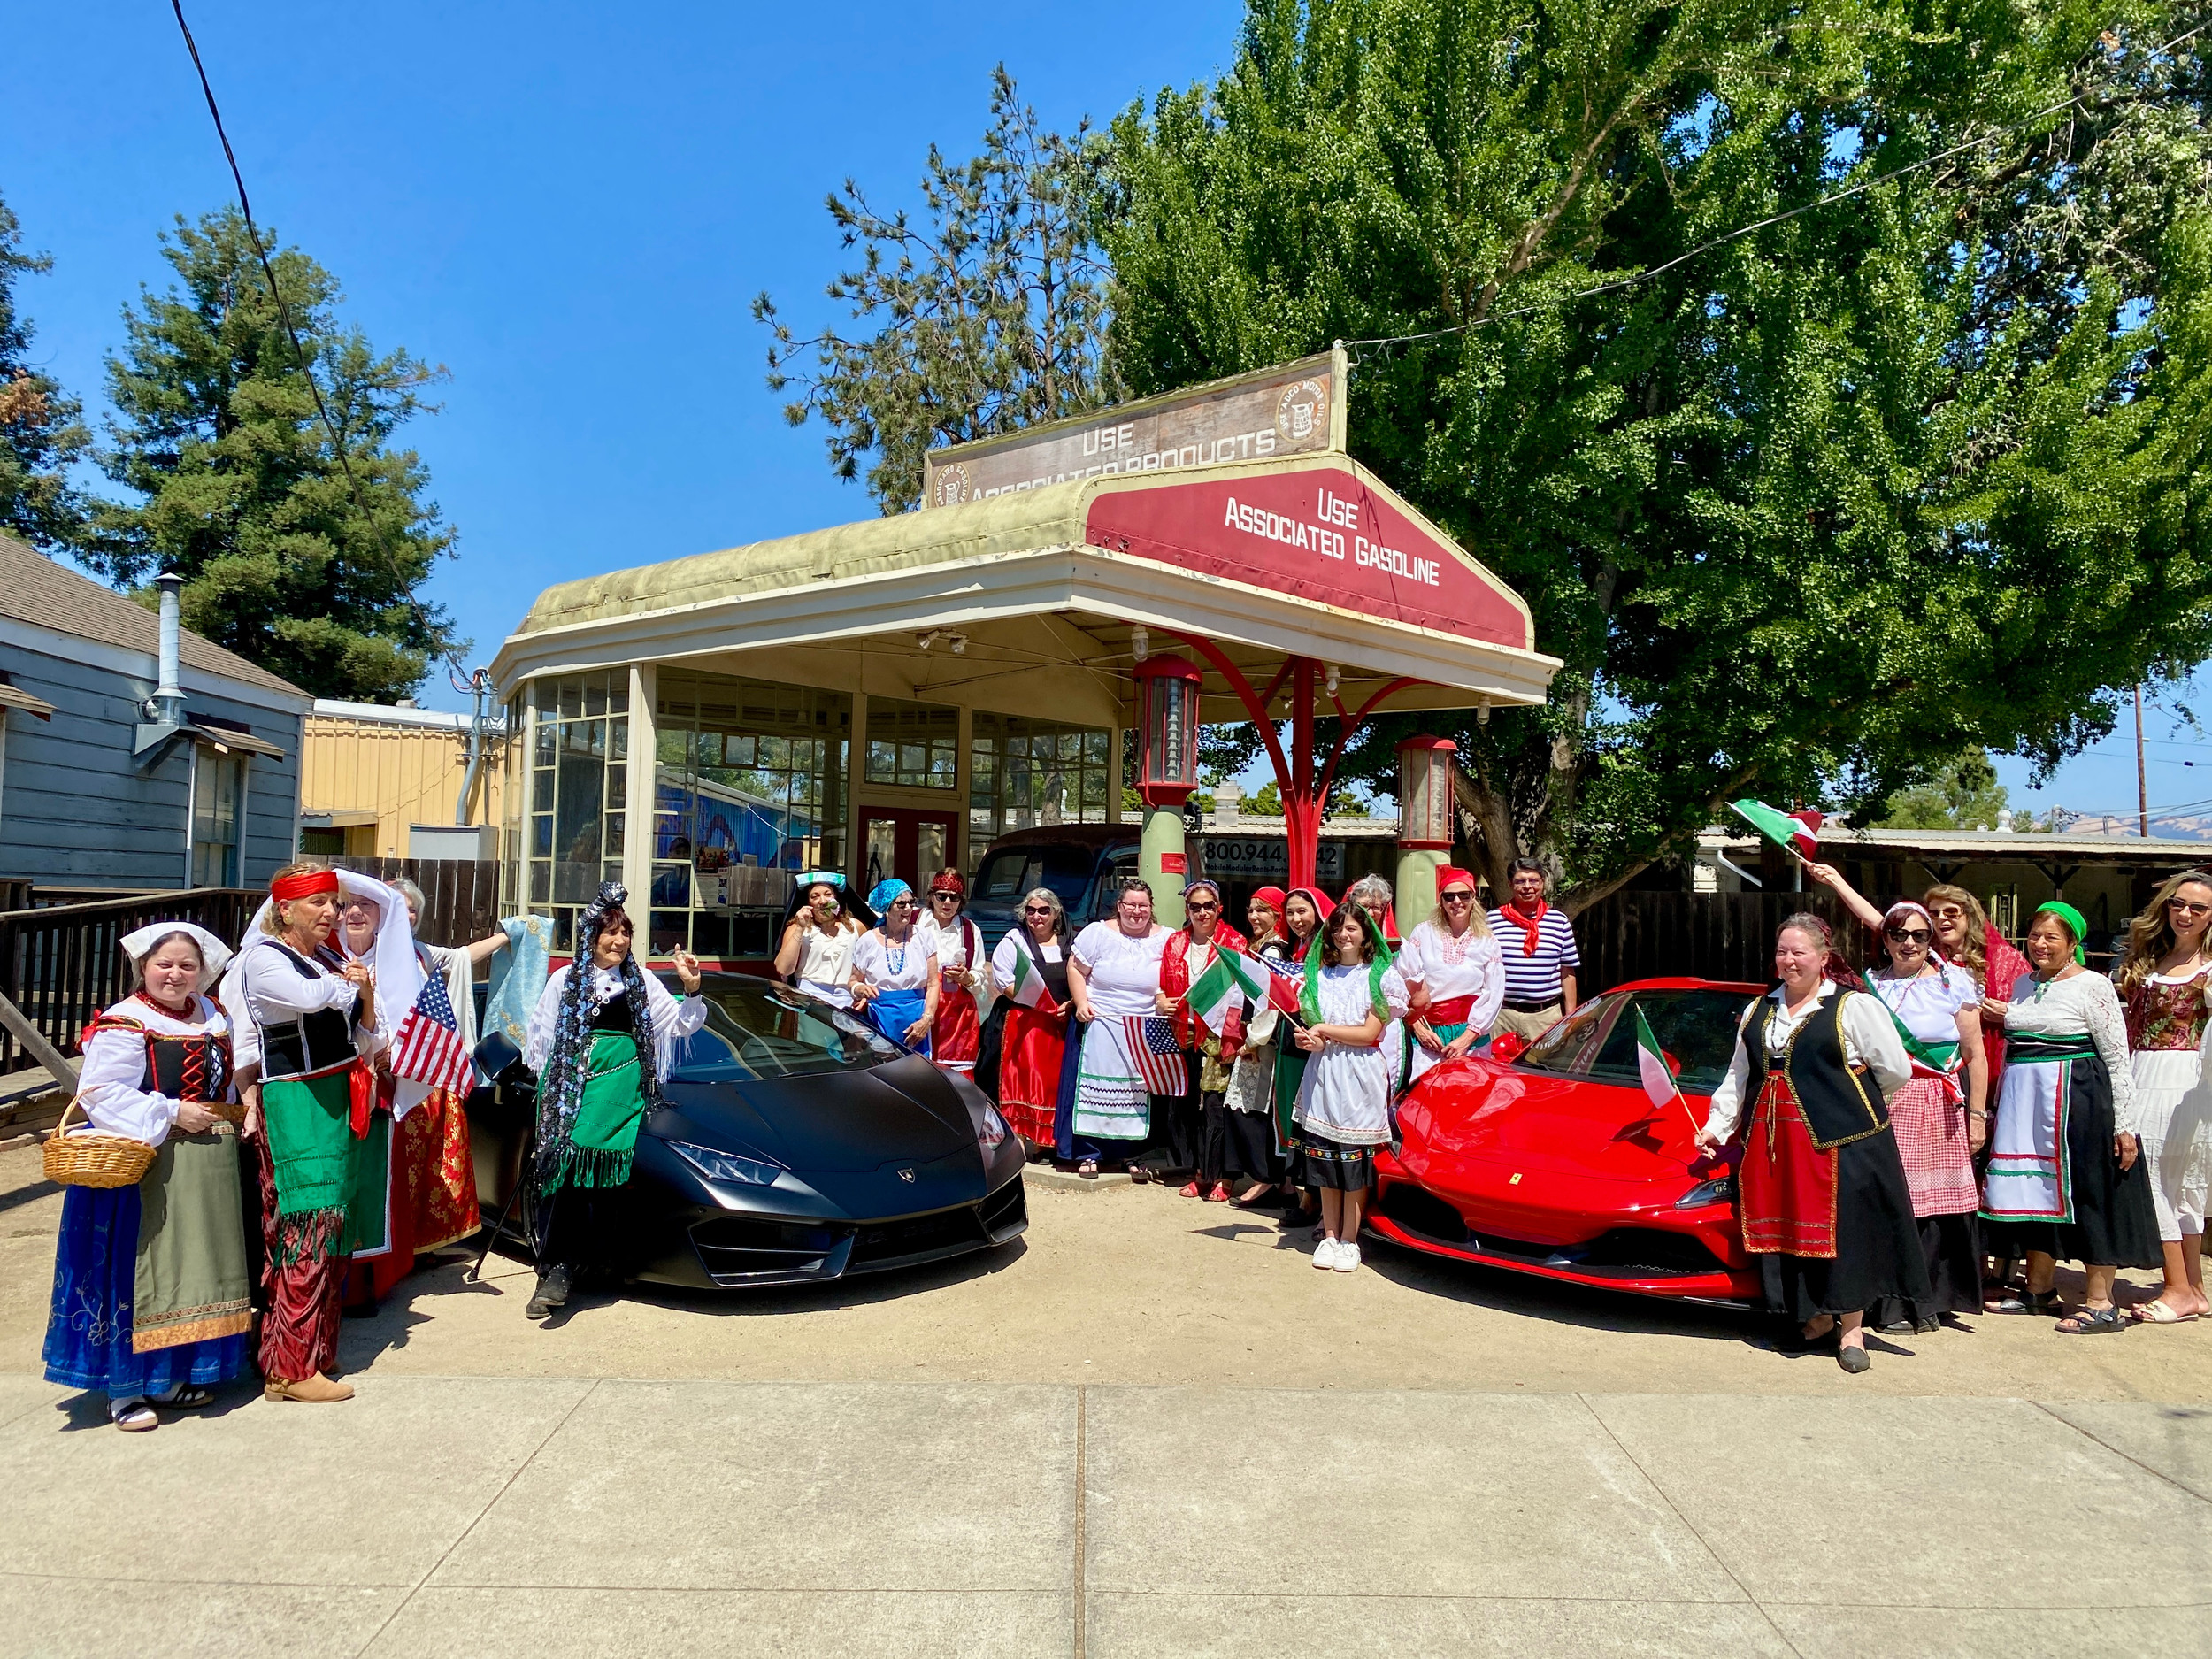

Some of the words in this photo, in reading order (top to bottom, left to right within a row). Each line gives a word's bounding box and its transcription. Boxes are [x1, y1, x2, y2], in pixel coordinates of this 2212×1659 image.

[1302, 380, 1324, 401] MOTOR
[1315, 404, 1325, 426] OILS
[1082, 423, 1134, 456] USE
[1125, 428, 1276, 472] PRODUCTS
[1317, 488, 1359, 530] USE
[1224, 496, 1345, 560] ASSOCIATED
[1355, 534, 1440, 587] GASOLINE
